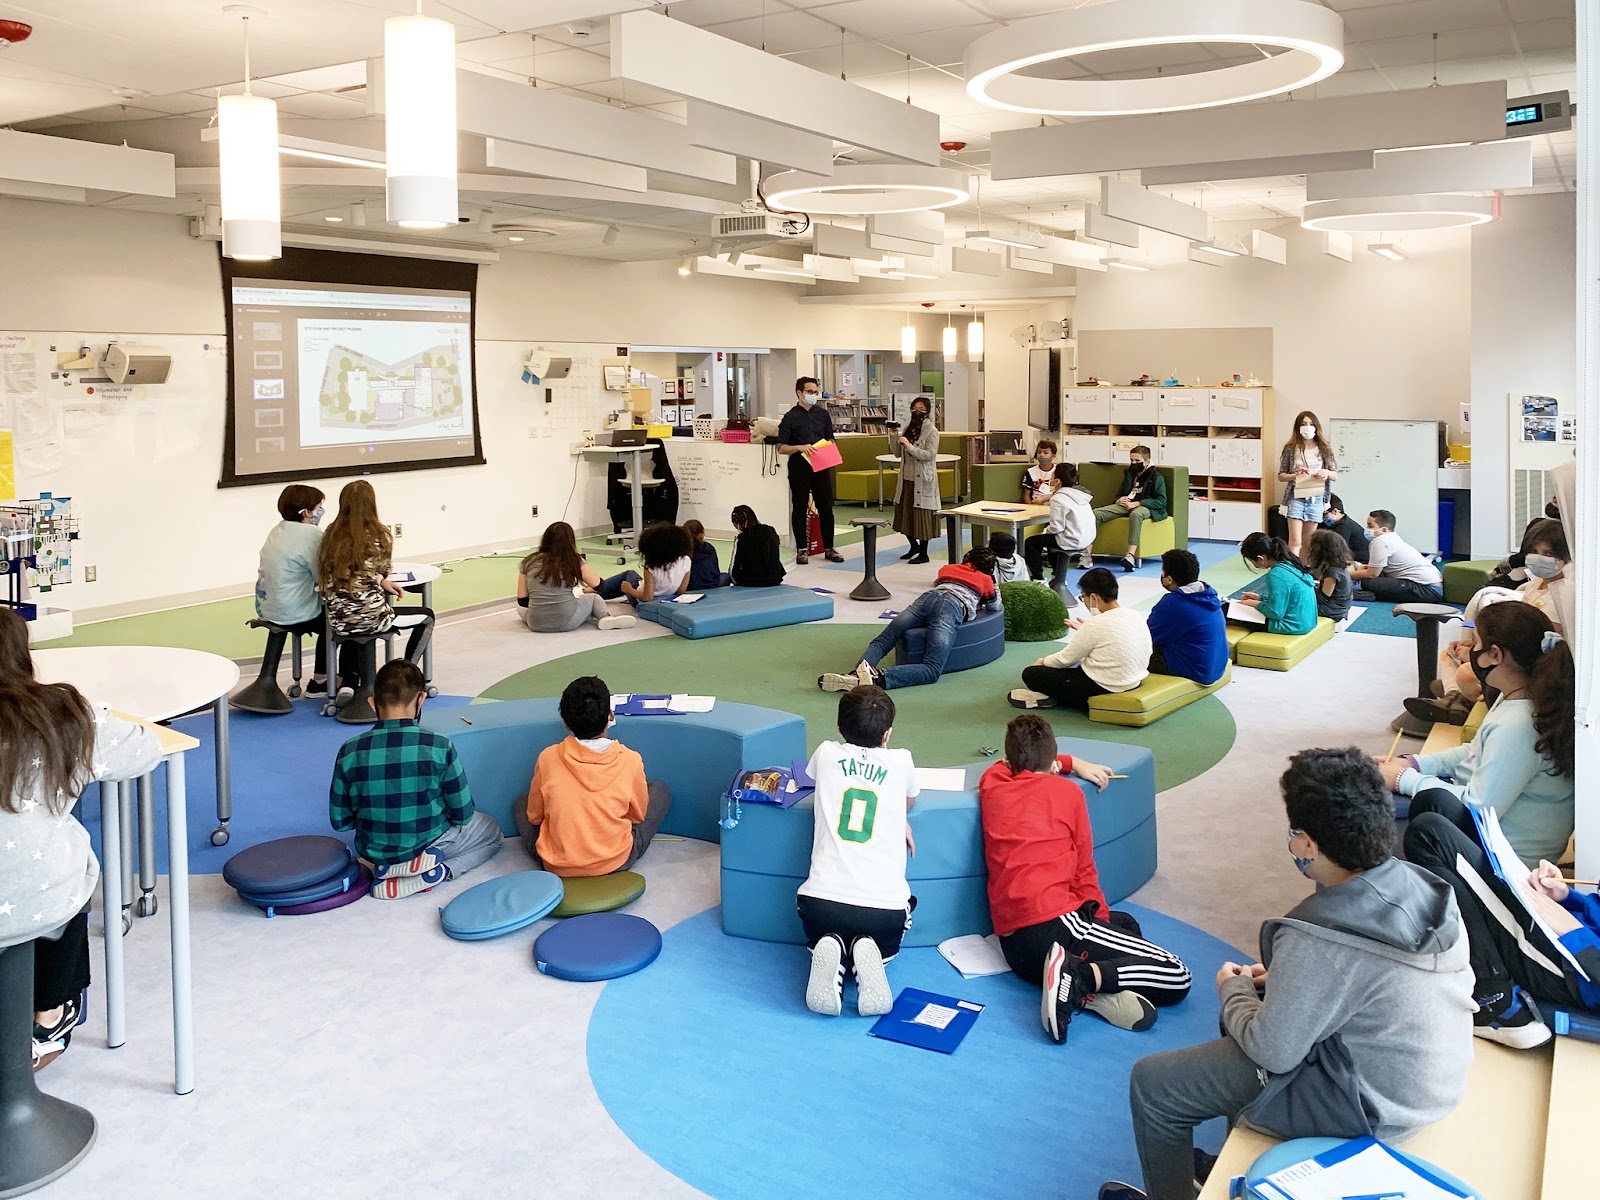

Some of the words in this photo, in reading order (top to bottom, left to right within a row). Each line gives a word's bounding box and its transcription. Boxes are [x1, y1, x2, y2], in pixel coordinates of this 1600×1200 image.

[838, 758, 888, 786] TATUM
[837, 785, 879, 845] 0
[1058, 972, 1072, 1003] PUMA
